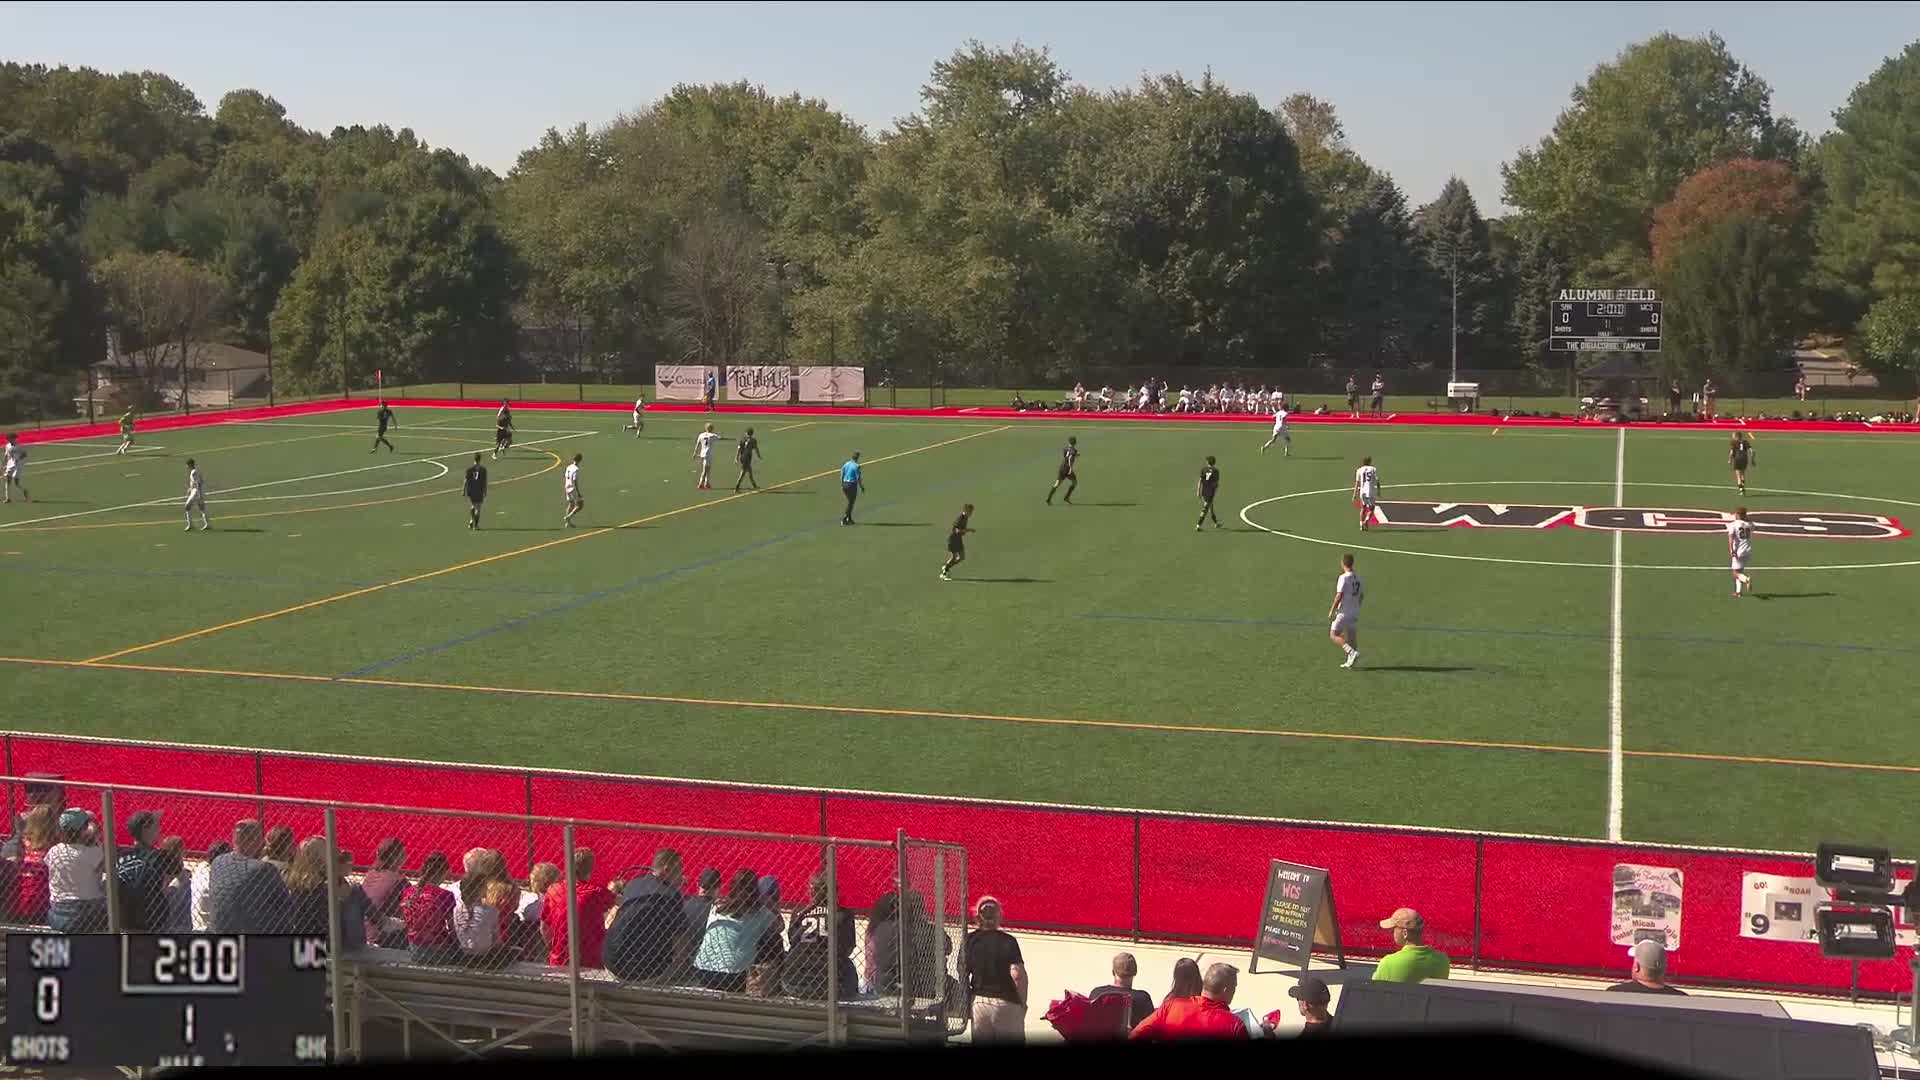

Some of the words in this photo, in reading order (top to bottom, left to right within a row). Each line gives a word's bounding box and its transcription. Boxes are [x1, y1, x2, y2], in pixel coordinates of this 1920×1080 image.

[1560, 289, 1615, 301] ALUMNI
[1616, 289, 1656, 301] FIELD
[1562, 312, 1569, 324] 0
[1651, 312, 1659, 324] 0
[675, 375, 705, 385] Coven
[1362, 471, 1372, 483] 15
[1282, 882, 1301, 899] WCS
[1753, 880, 1768, 890] GO!
[1632, 920, 1656, 929] Micah
